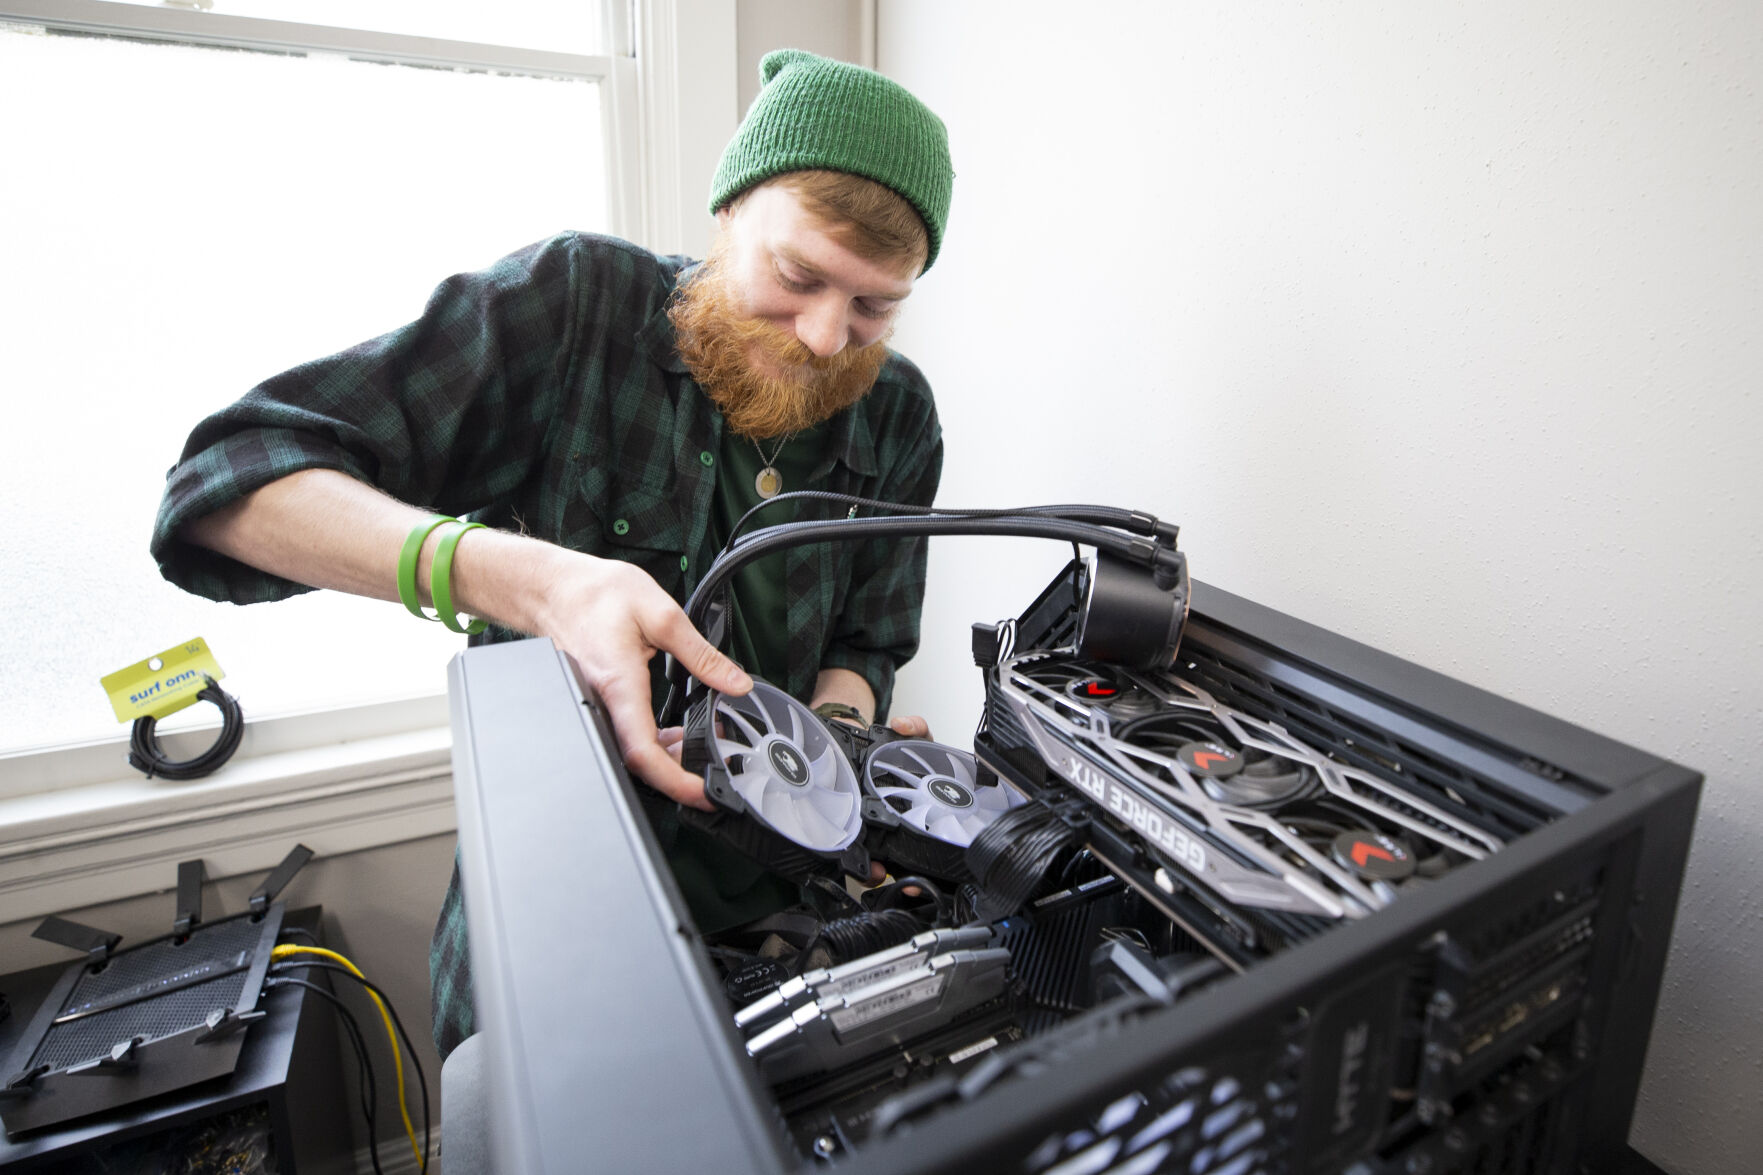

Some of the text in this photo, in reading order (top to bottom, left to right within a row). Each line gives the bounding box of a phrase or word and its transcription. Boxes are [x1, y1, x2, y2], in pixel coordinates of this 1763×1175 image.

[130, 681, 161, 703] surf
[166, 669, 196, 688] onn
[1069, 757, 1206, 872] GEFORCE RTX
